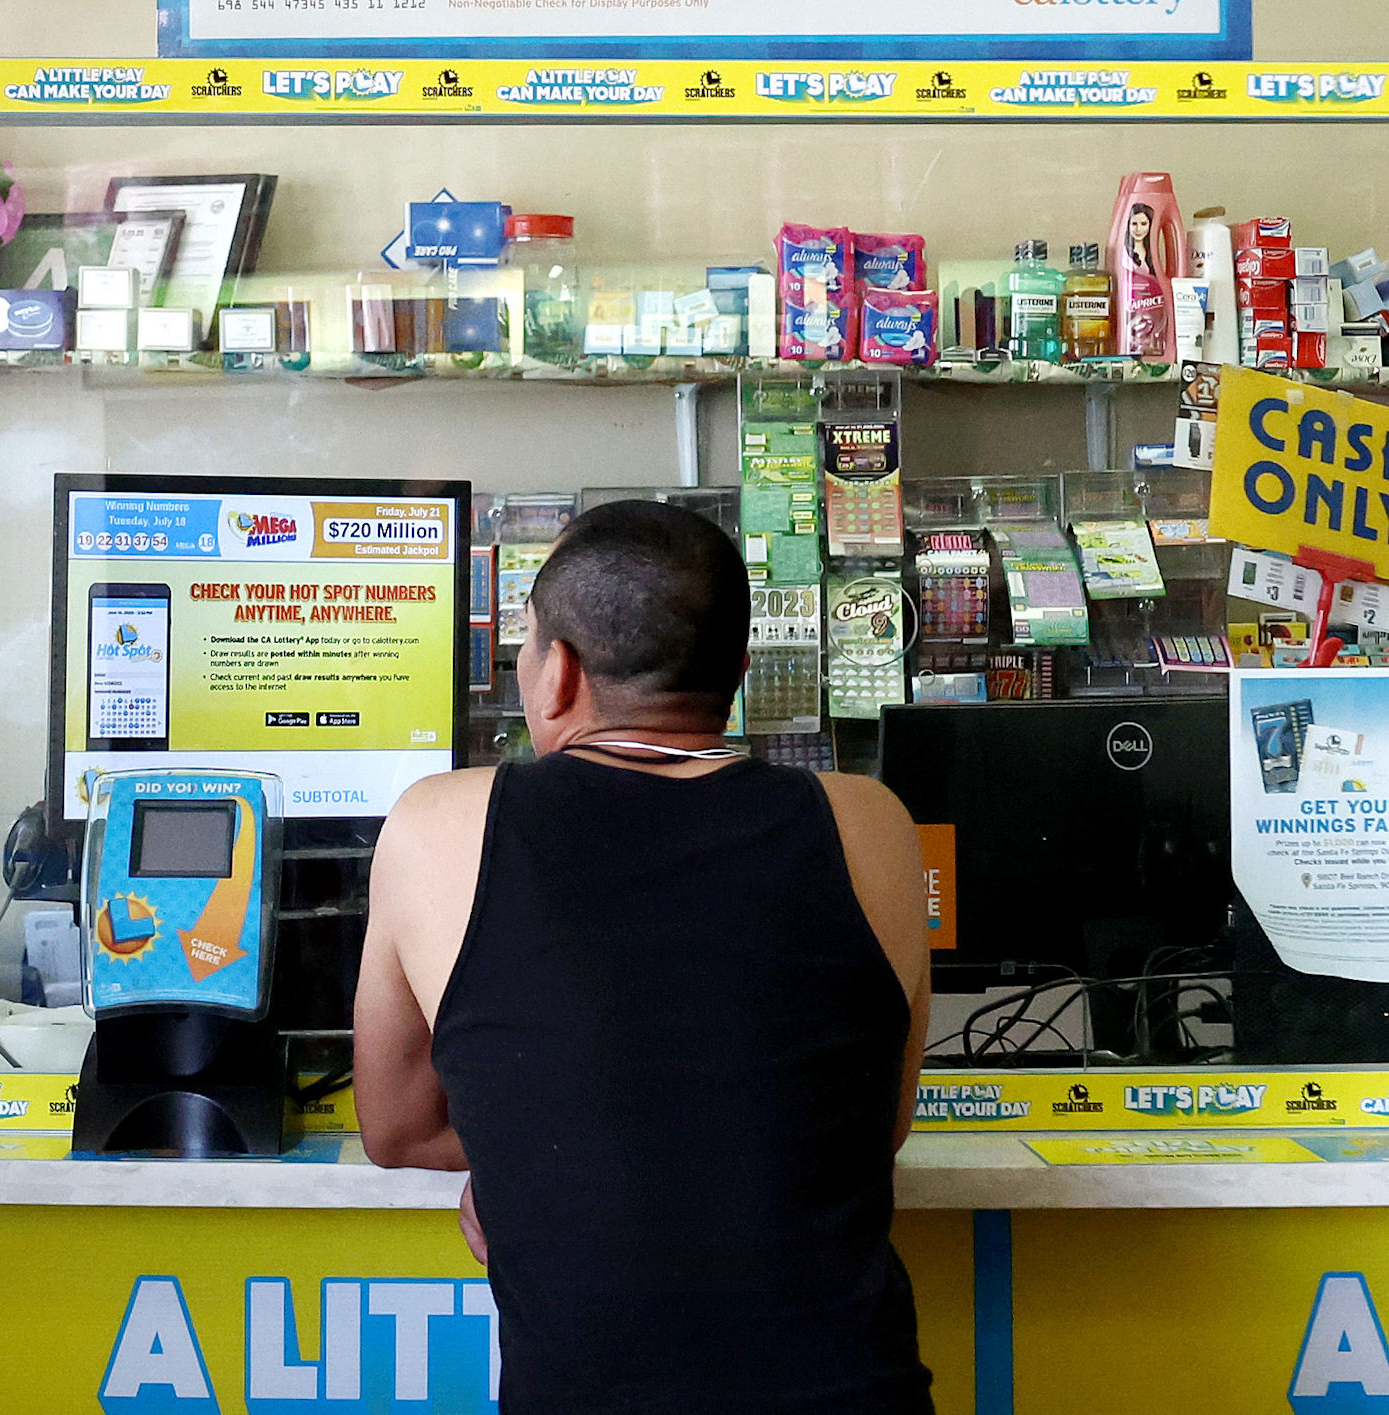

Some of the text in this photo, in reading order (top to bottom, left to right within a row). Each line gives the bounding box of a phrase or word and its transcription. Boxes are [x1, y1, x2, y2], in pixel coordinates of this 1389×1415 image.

[34, 66, 146, 84] A LITTLE PLAY
[262, 68, 405, 95] LET'S PLAY
[4, 84, 172, 100] CAN MAKE YOUR DAY
[792, 249, 832, 265] always
[1017, 298, 1055, 307] LISTERINE
[1068, 300, 1107, 310] LISTERINE
[875, 316, 917, 333] always
[832, 429, 892, 445] XTREME
[105, 500, 190, 513] Winning Numbers
[376, 506, 442, 519] Friday, July 21
[153, 516, 173, 529] July
[175, 517, 187, 527] 18
[252, 515, 298, 535] MEGA
[328, 520, 440, 540] $720 Million
[77, 534, 169, 547] 19 22 31 37 54
[354, 544, 440, 558] Estimated Jackpot
[190, 583, 437, 602] CHECK YOUR HOT SPOT NUMBERS
[1267, 586, 1279, 602] $3
[752, 590, 817, 618] 2023
[836, 596, 894, 621] Cloud
[233, 604, 399, 624] ANYTIME, ANYWHERE.
[1363, 610, 1377, 626] $2
[871, 614, 890, 636] 9
[211, 636, 245, 644] Download
[247, 636, 259, 644] the
[261, 636, 272, 644] CA
[305, 636, 320, 646] App
[321, 636, 341, 646] today
[342, 636, 350, 644] or
[351, 636, 362, 646] go
[363, 636, 371, 644] to
[371, 636, 420, 646] calottery.com
[96, 643, 153, 660] Hot Spot
[1112, 737, 1149, 753] DELL
[135, 783, 162, 794] DID
[202, 782, 242, 794] WIN?
[292, 790, 369, 804] SUBTOTAL
[1300, 800, 1339, 815] GET
[1256, 819, 1356, 834] WINNINGS
[190, 937, 228, 958] CHECK
[190, 948, 222, 966] HERE
[1123, 1083, 1268, 1111] LET'S PLAY
[103, 1274, 500, 1402] A LIT
